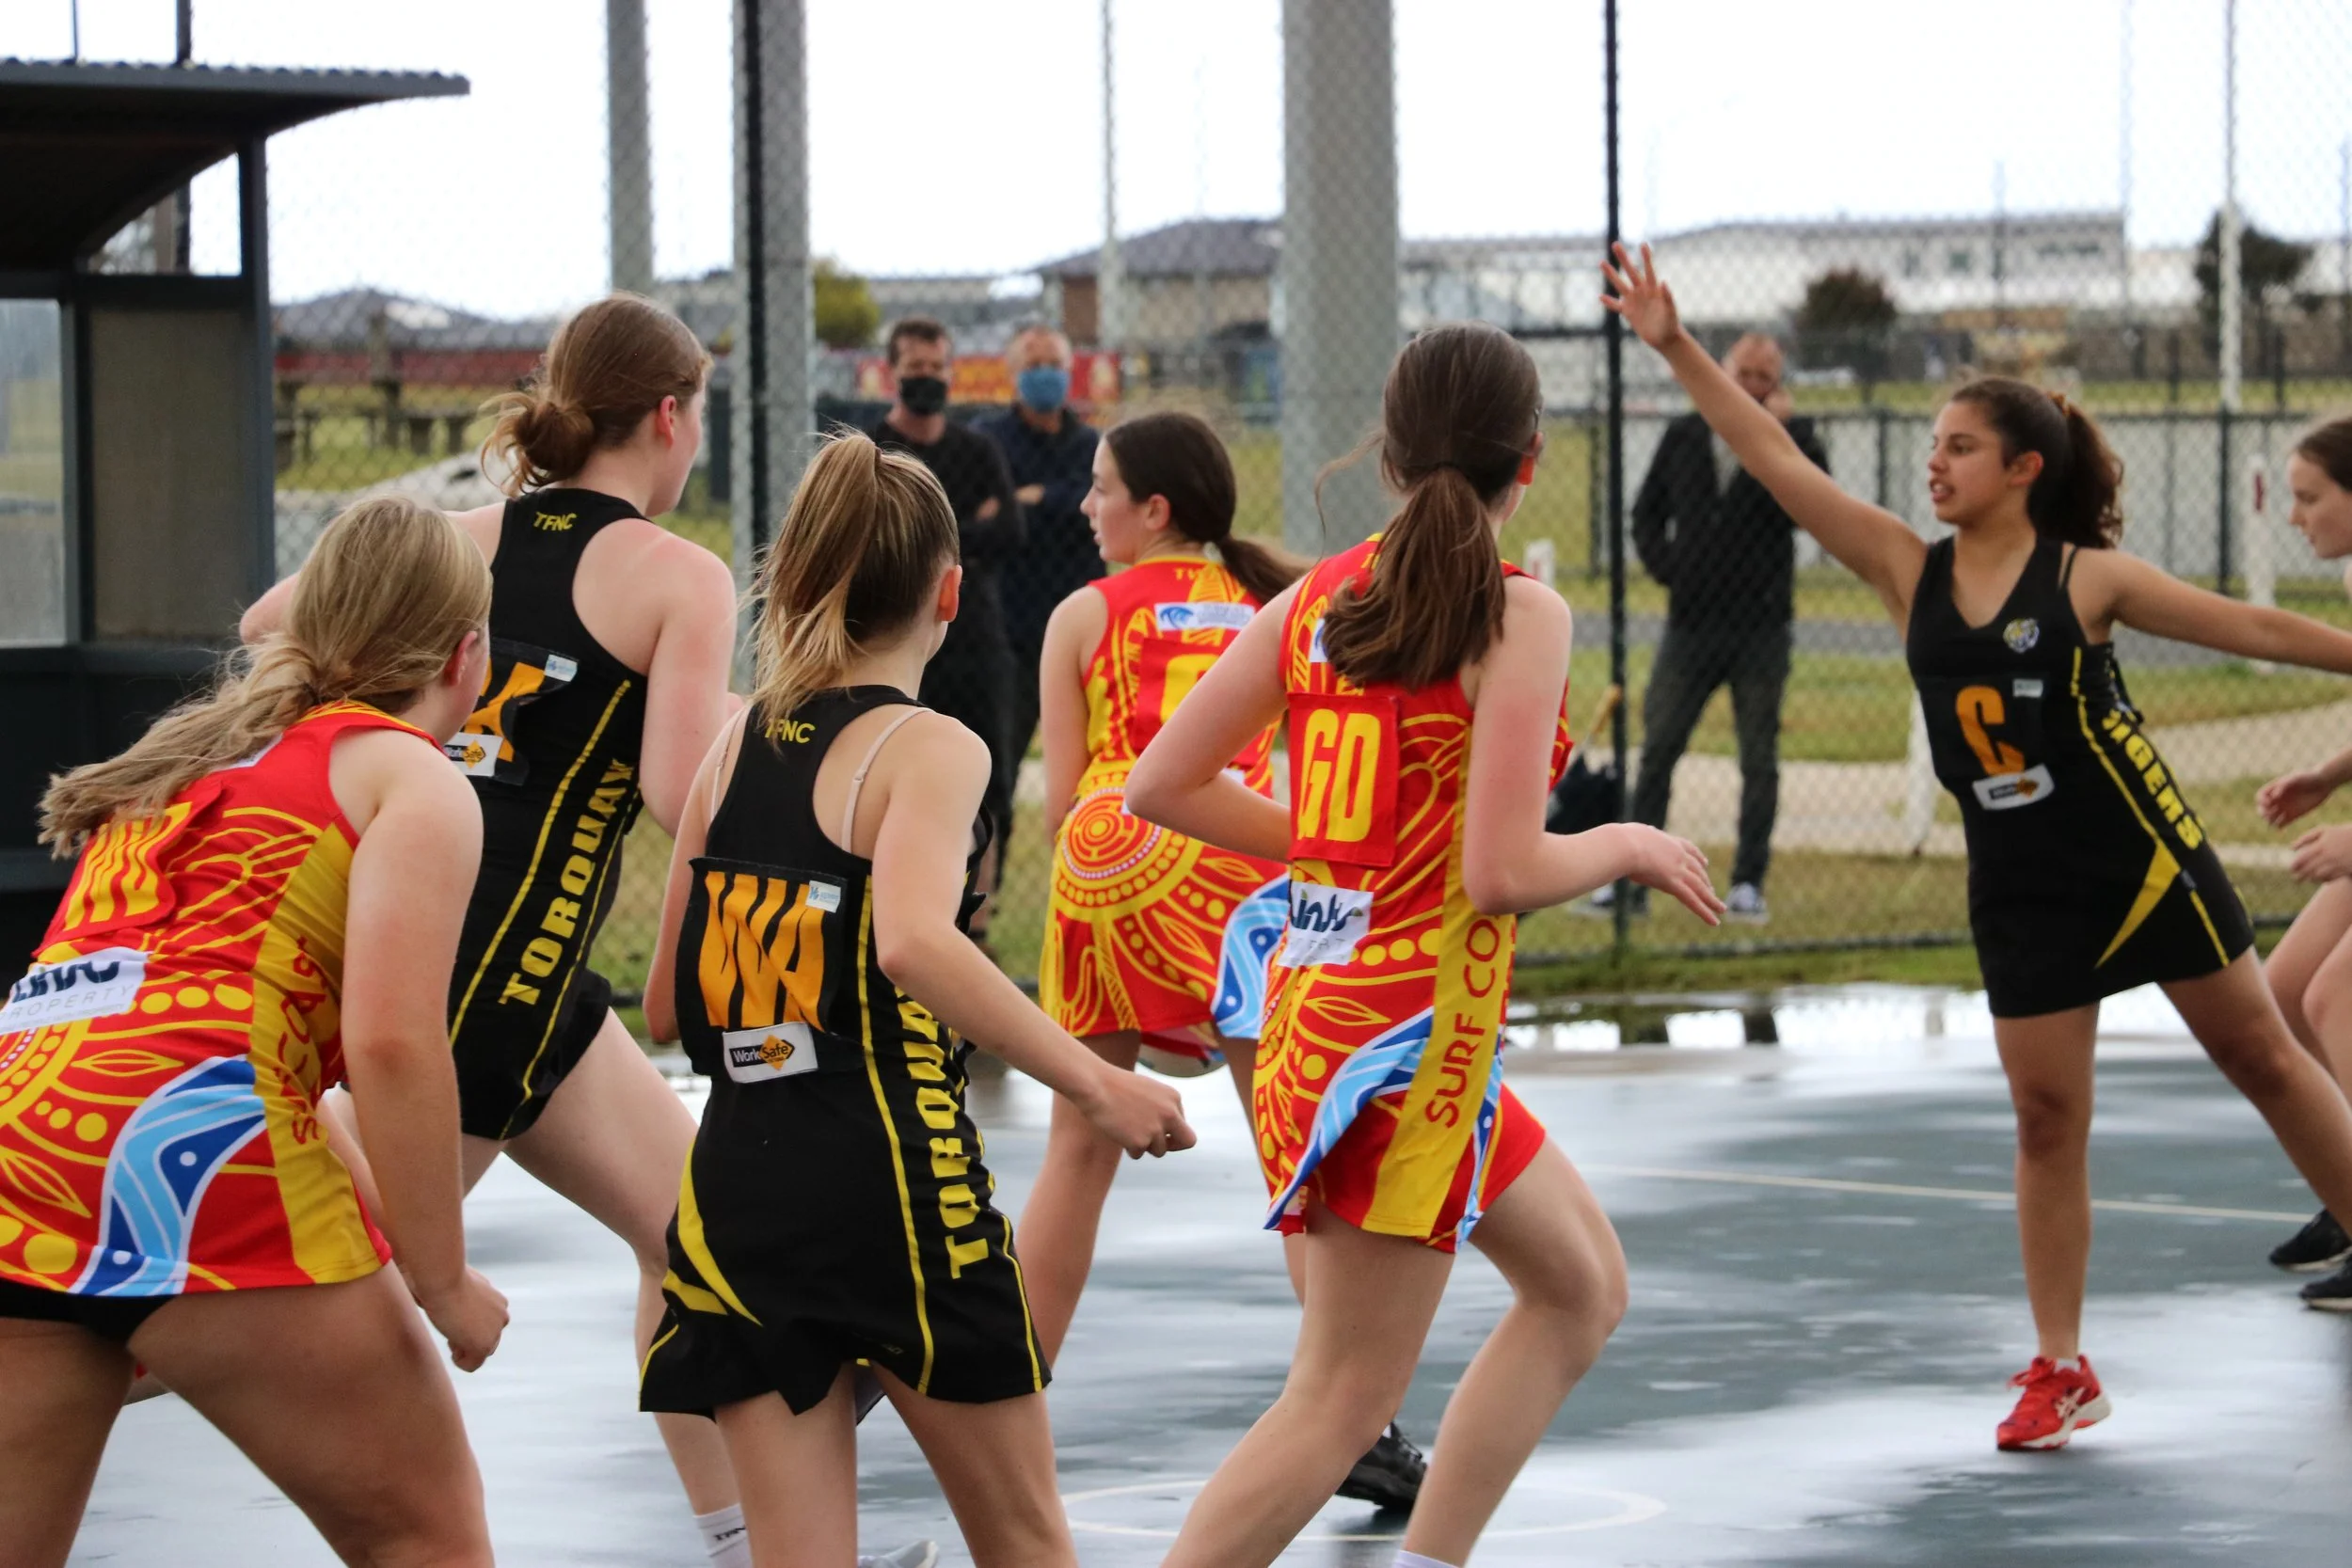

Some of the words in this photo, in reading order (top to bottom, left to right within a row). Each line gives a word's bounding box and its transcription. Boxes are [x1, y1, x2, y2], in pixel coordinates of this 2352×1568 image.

[533, 512, 578, 531] TFNC
[1297, 708, 1381, 842] GD
[1956, 685, 2025, 776] C
[497, 758, 634, 1006] TORQUAY
[698, 870, 826, 1034] WA
[733, 1043, 789, 1064] WorkSafe
[1424, 1013, 1486, 1129] SURF
[895, 987, 990, 1280] TORQUA
